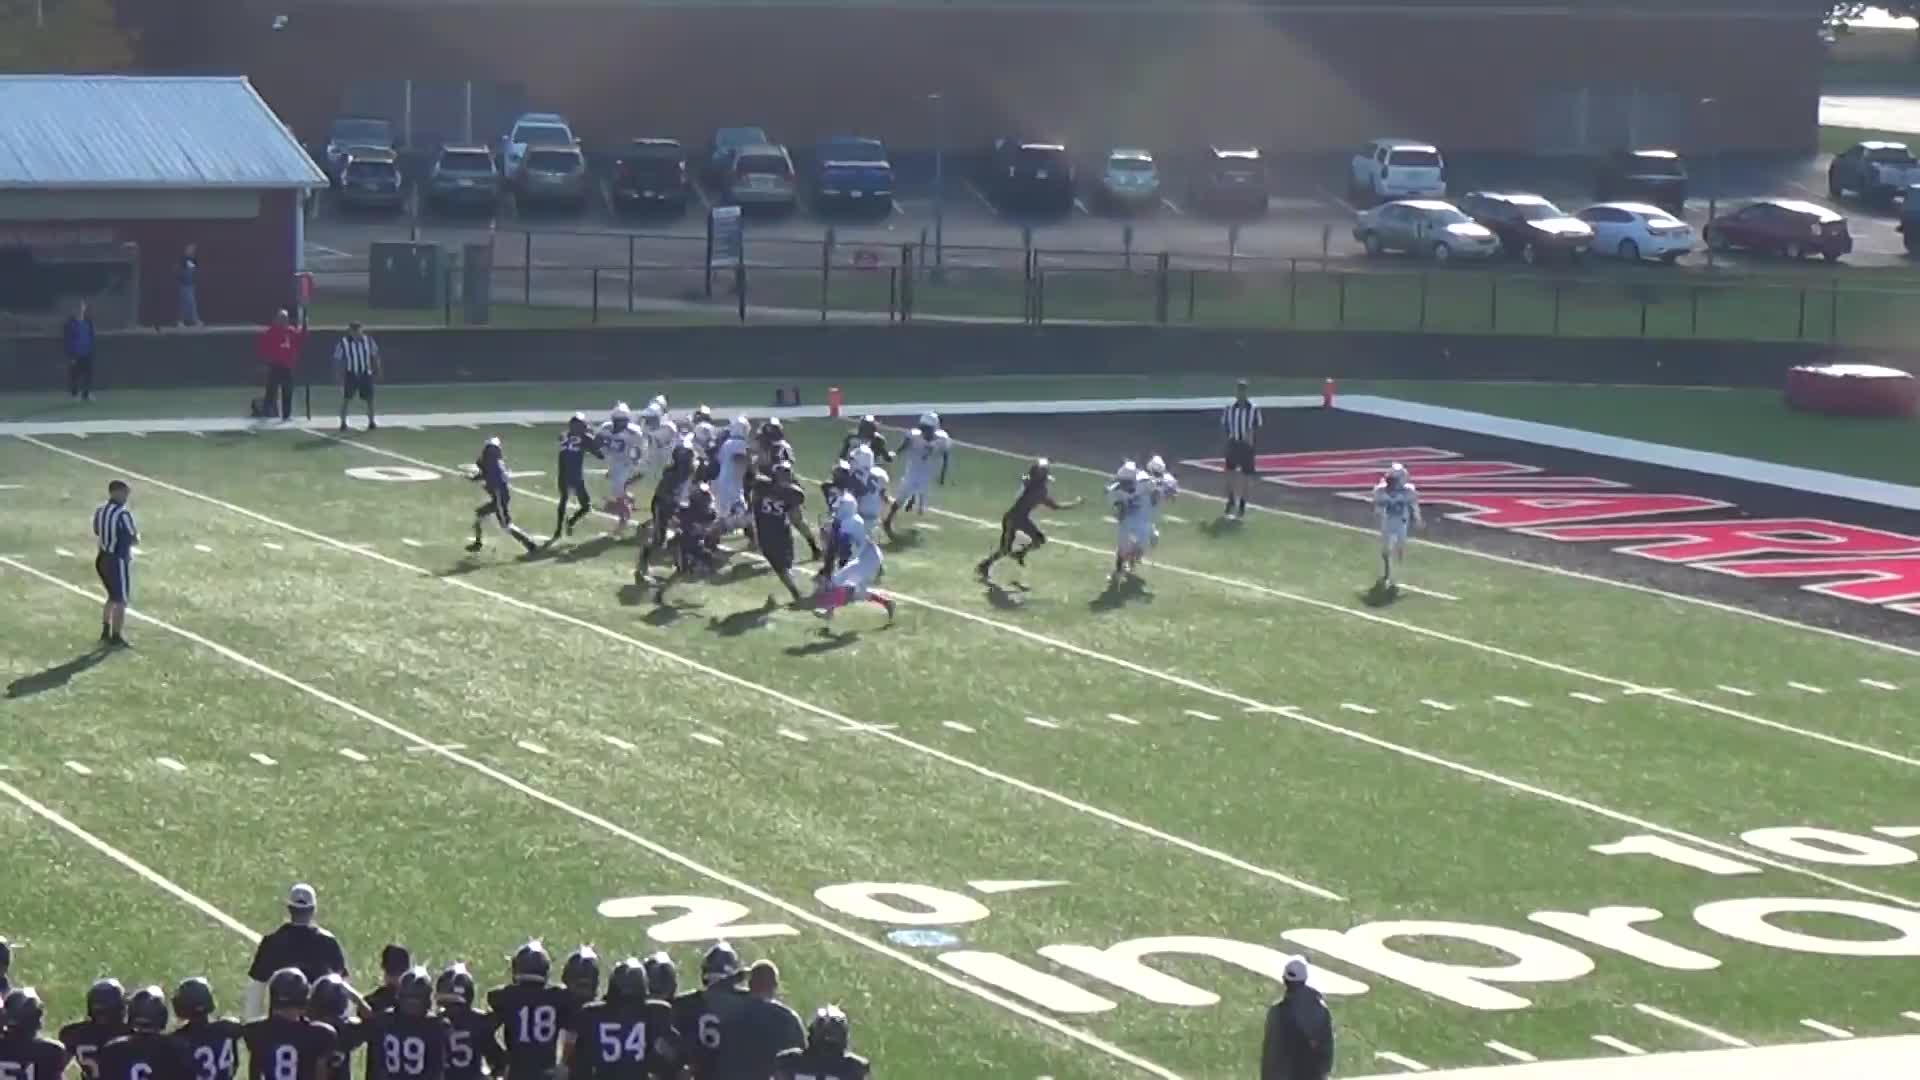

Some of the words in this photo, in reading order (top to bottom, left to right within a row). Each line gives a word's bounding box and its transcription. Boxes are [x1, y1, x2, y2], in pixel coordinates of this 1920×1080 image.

[596, 894, 990, 943] 20
[518, 1005, 556, 1043] 18
[600, 1022, 647, 1062] 54
[699, 1014, 721, 1048] 6
[193, 1037, 234, 1080] 34
[274, 1044, 299, 1080] 8
[384, 1033, 425, 1075] 89
